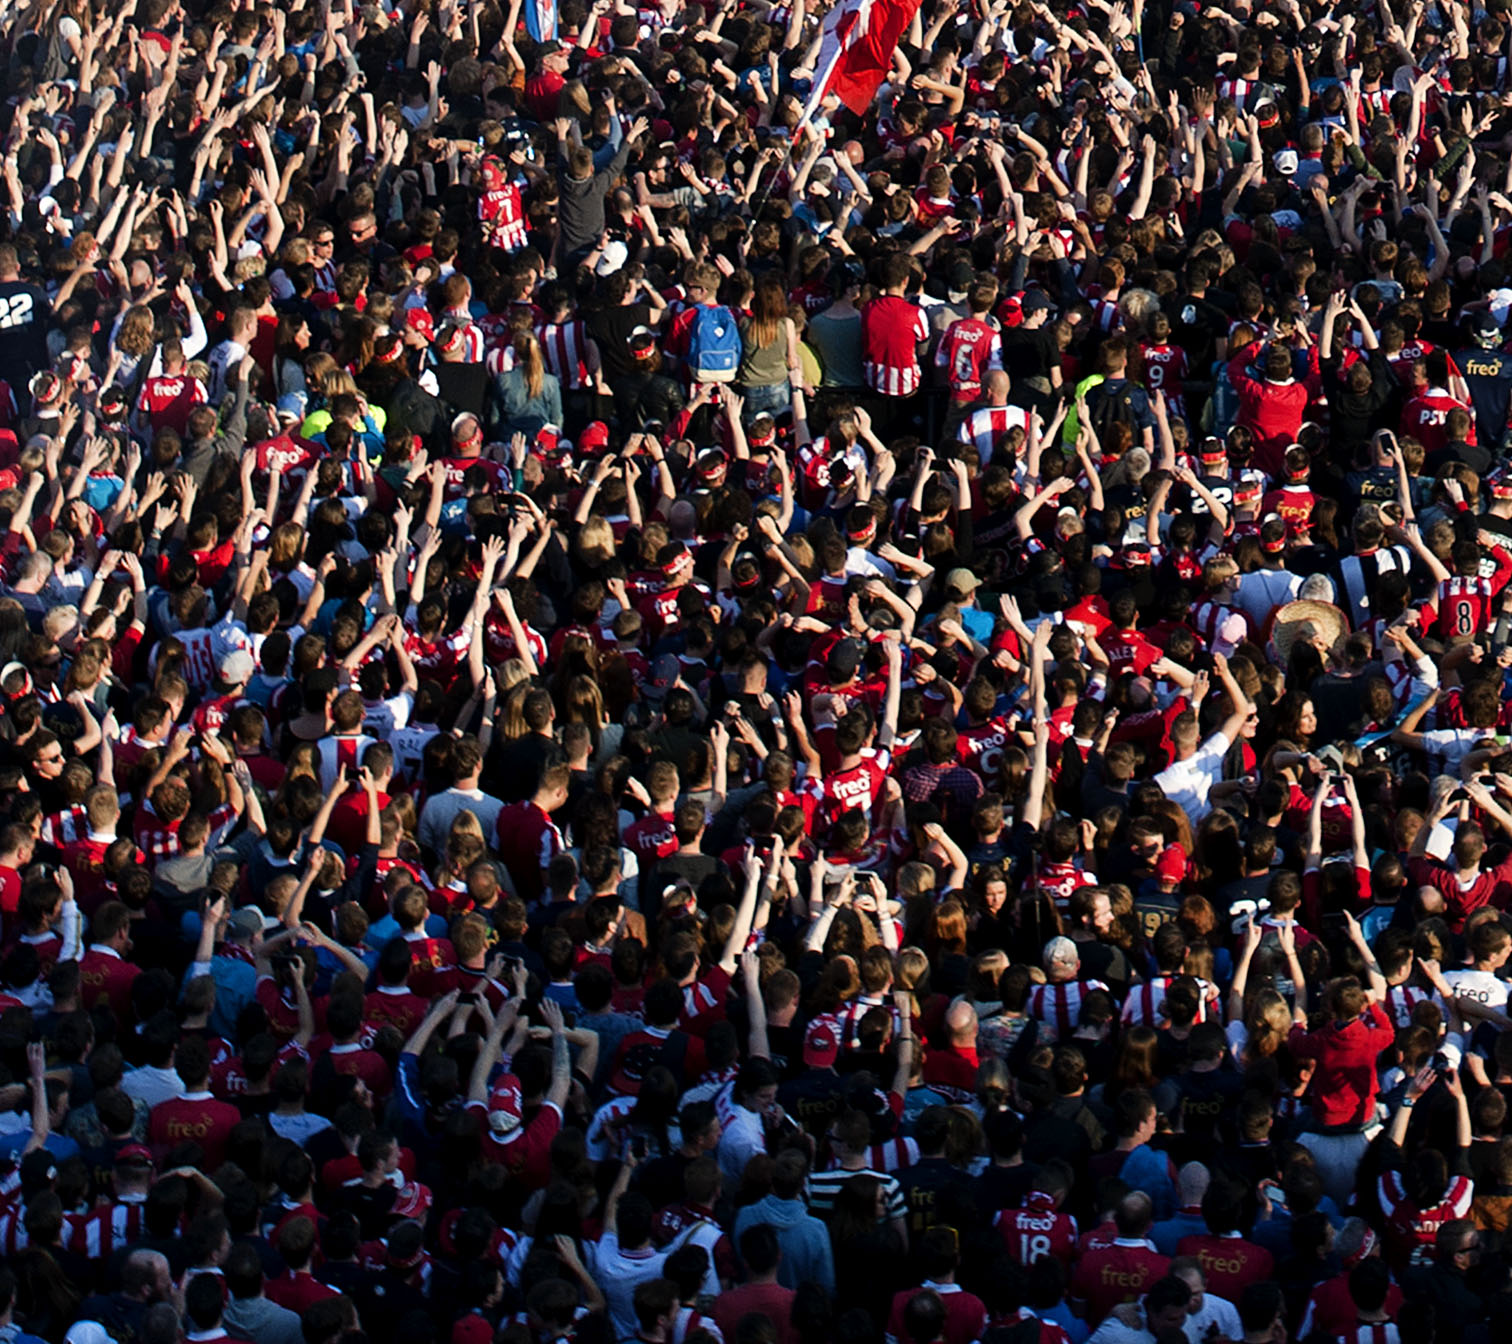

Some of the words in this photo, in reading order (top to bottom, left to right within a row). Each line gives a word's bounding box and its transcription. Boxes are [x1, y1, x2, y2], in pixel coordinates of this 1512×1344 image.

[953, 326, 984, 342] freo
[1149, 365, 1164, 388] 9
[1466, 358, 1502, 376] freo
[153, 381, 184, 396] freo
[1361, 478, 1395, 497] freo
[1456, 600, 1474, 635] 8
[968, 731, 1005, 754] freo
[832, 768, 872, 799] freo
[637, 830, 673, 849] freo
[167, 1113, 214, 1138] freo
[1015, 1211, 1058, 1232] freo
[1020, 1234, 1051, 1265] 18
[1197, 1248, 1247, 1273] freo
[1100, 1262, 1150, 1288] freo
